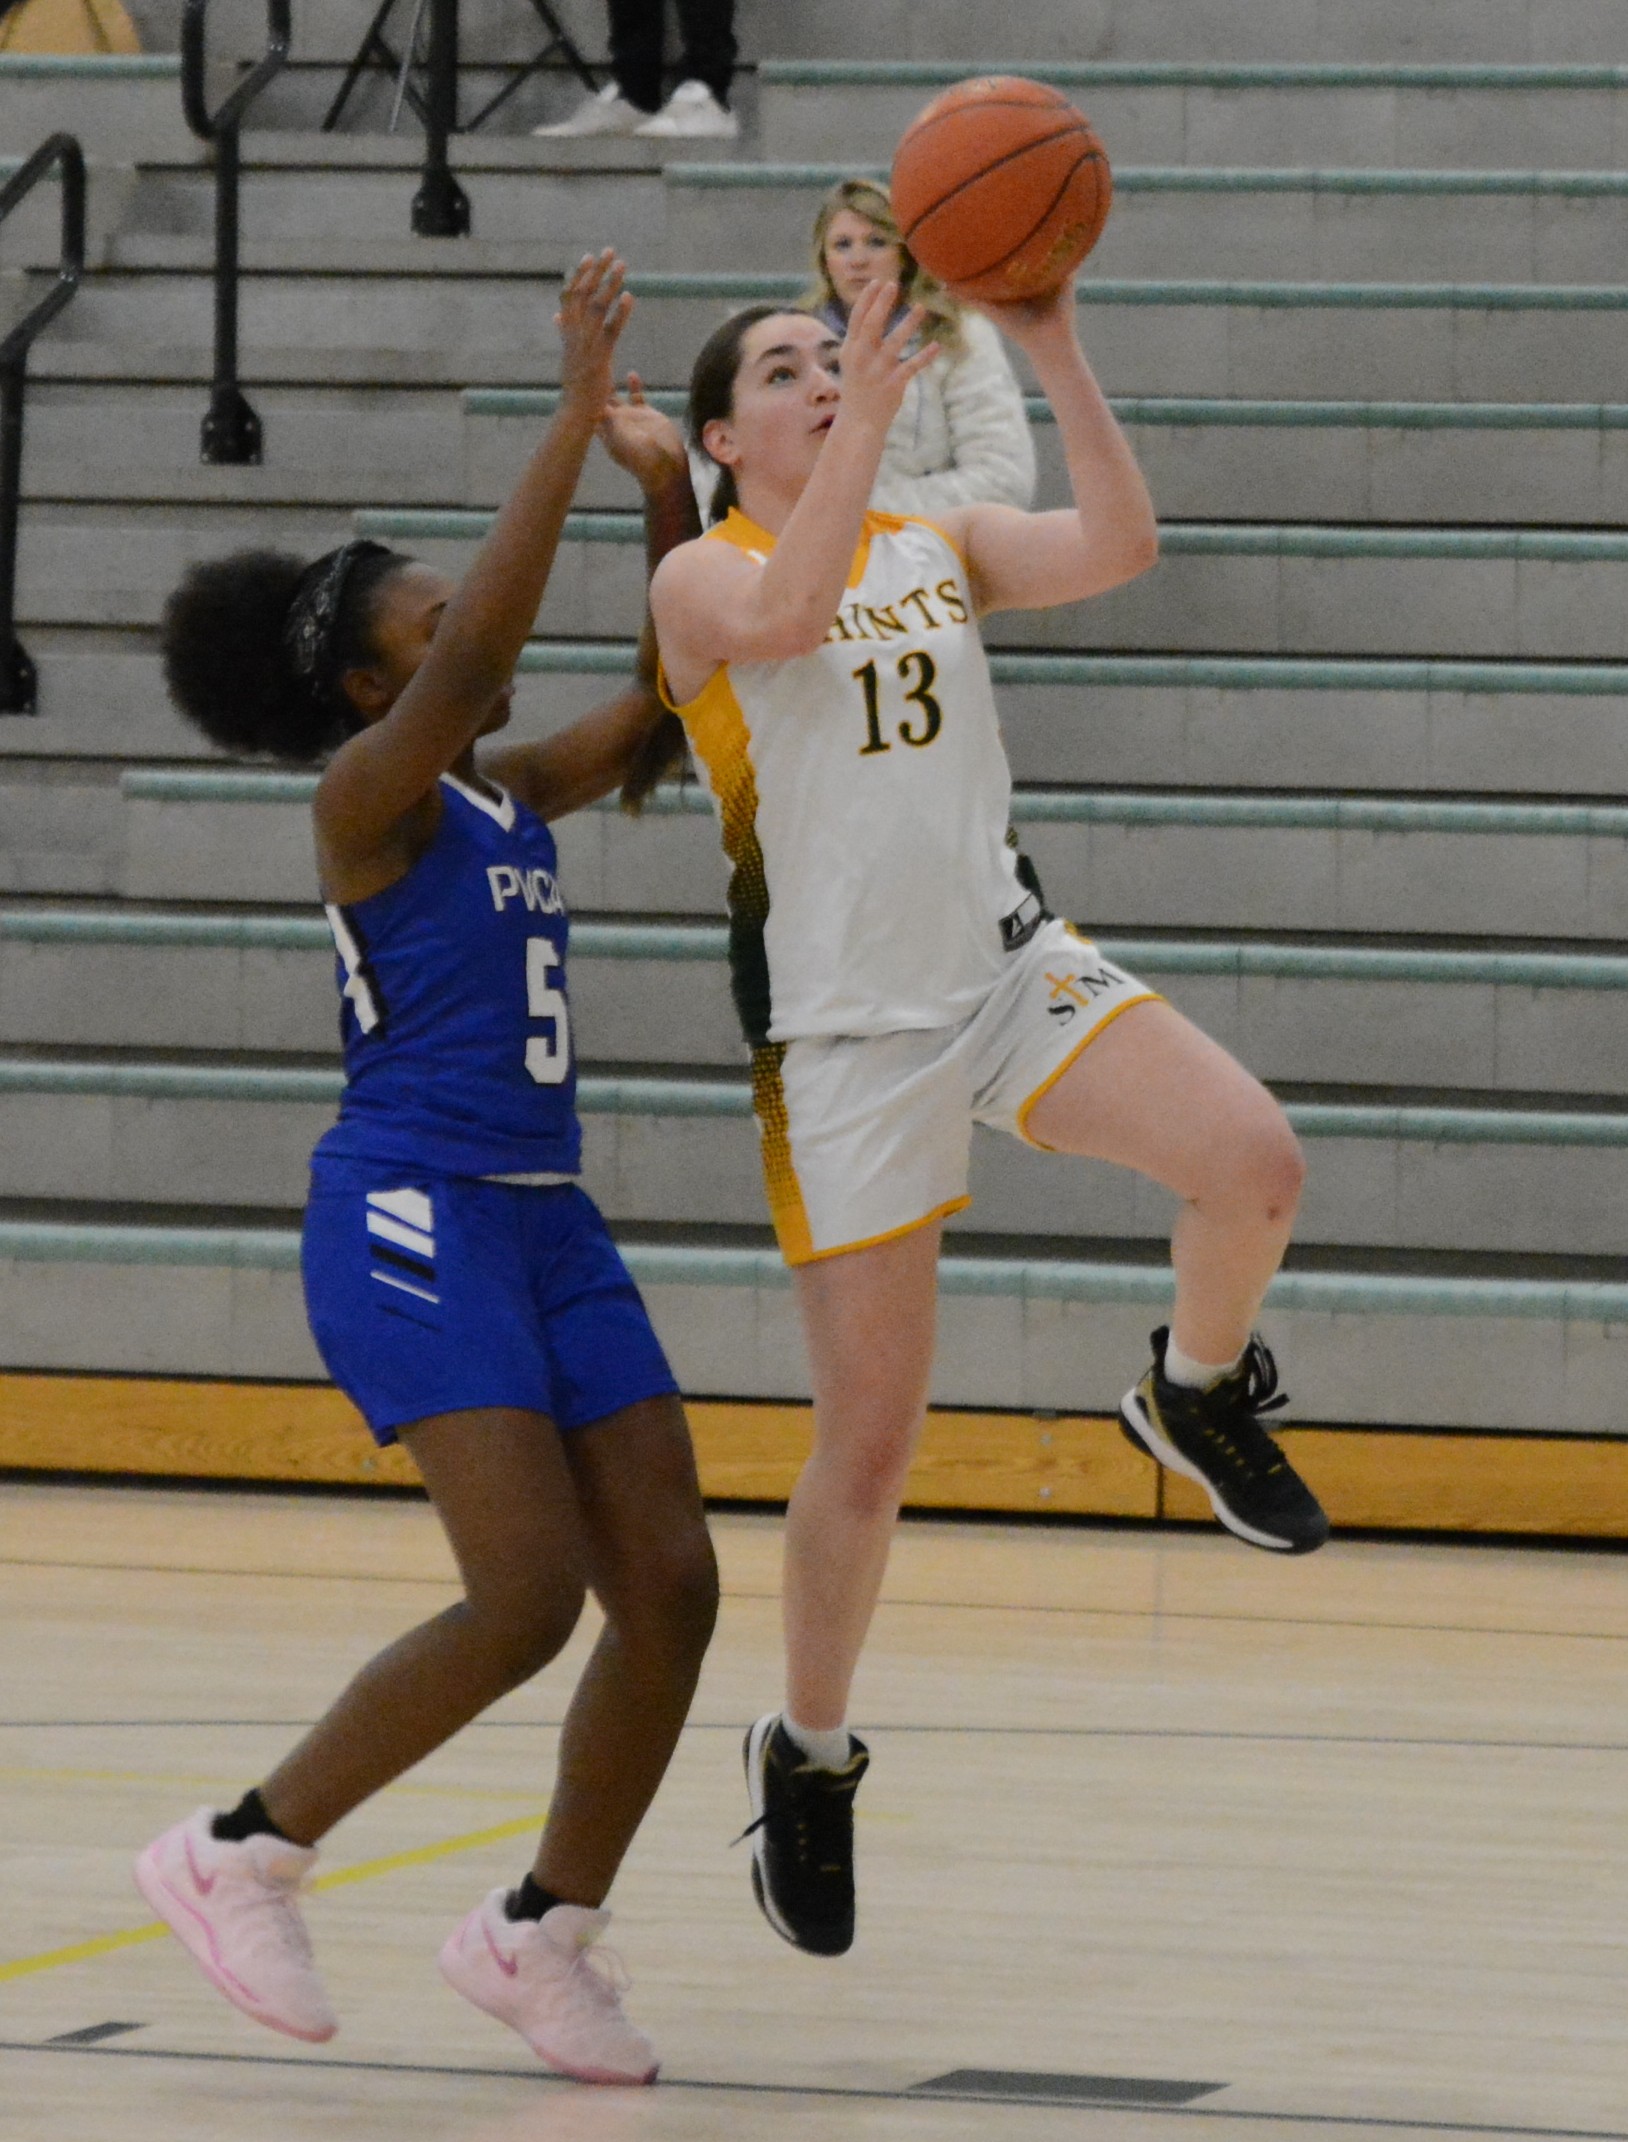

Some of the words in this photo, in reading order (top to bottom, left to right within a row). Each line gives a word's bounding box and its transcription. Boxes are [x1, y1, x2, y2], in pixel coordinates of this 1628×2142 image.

[822, 578, 969, 643] AINTS
[852, 651, 942, 756] 13
[525, 937, 570, 1084] 5
